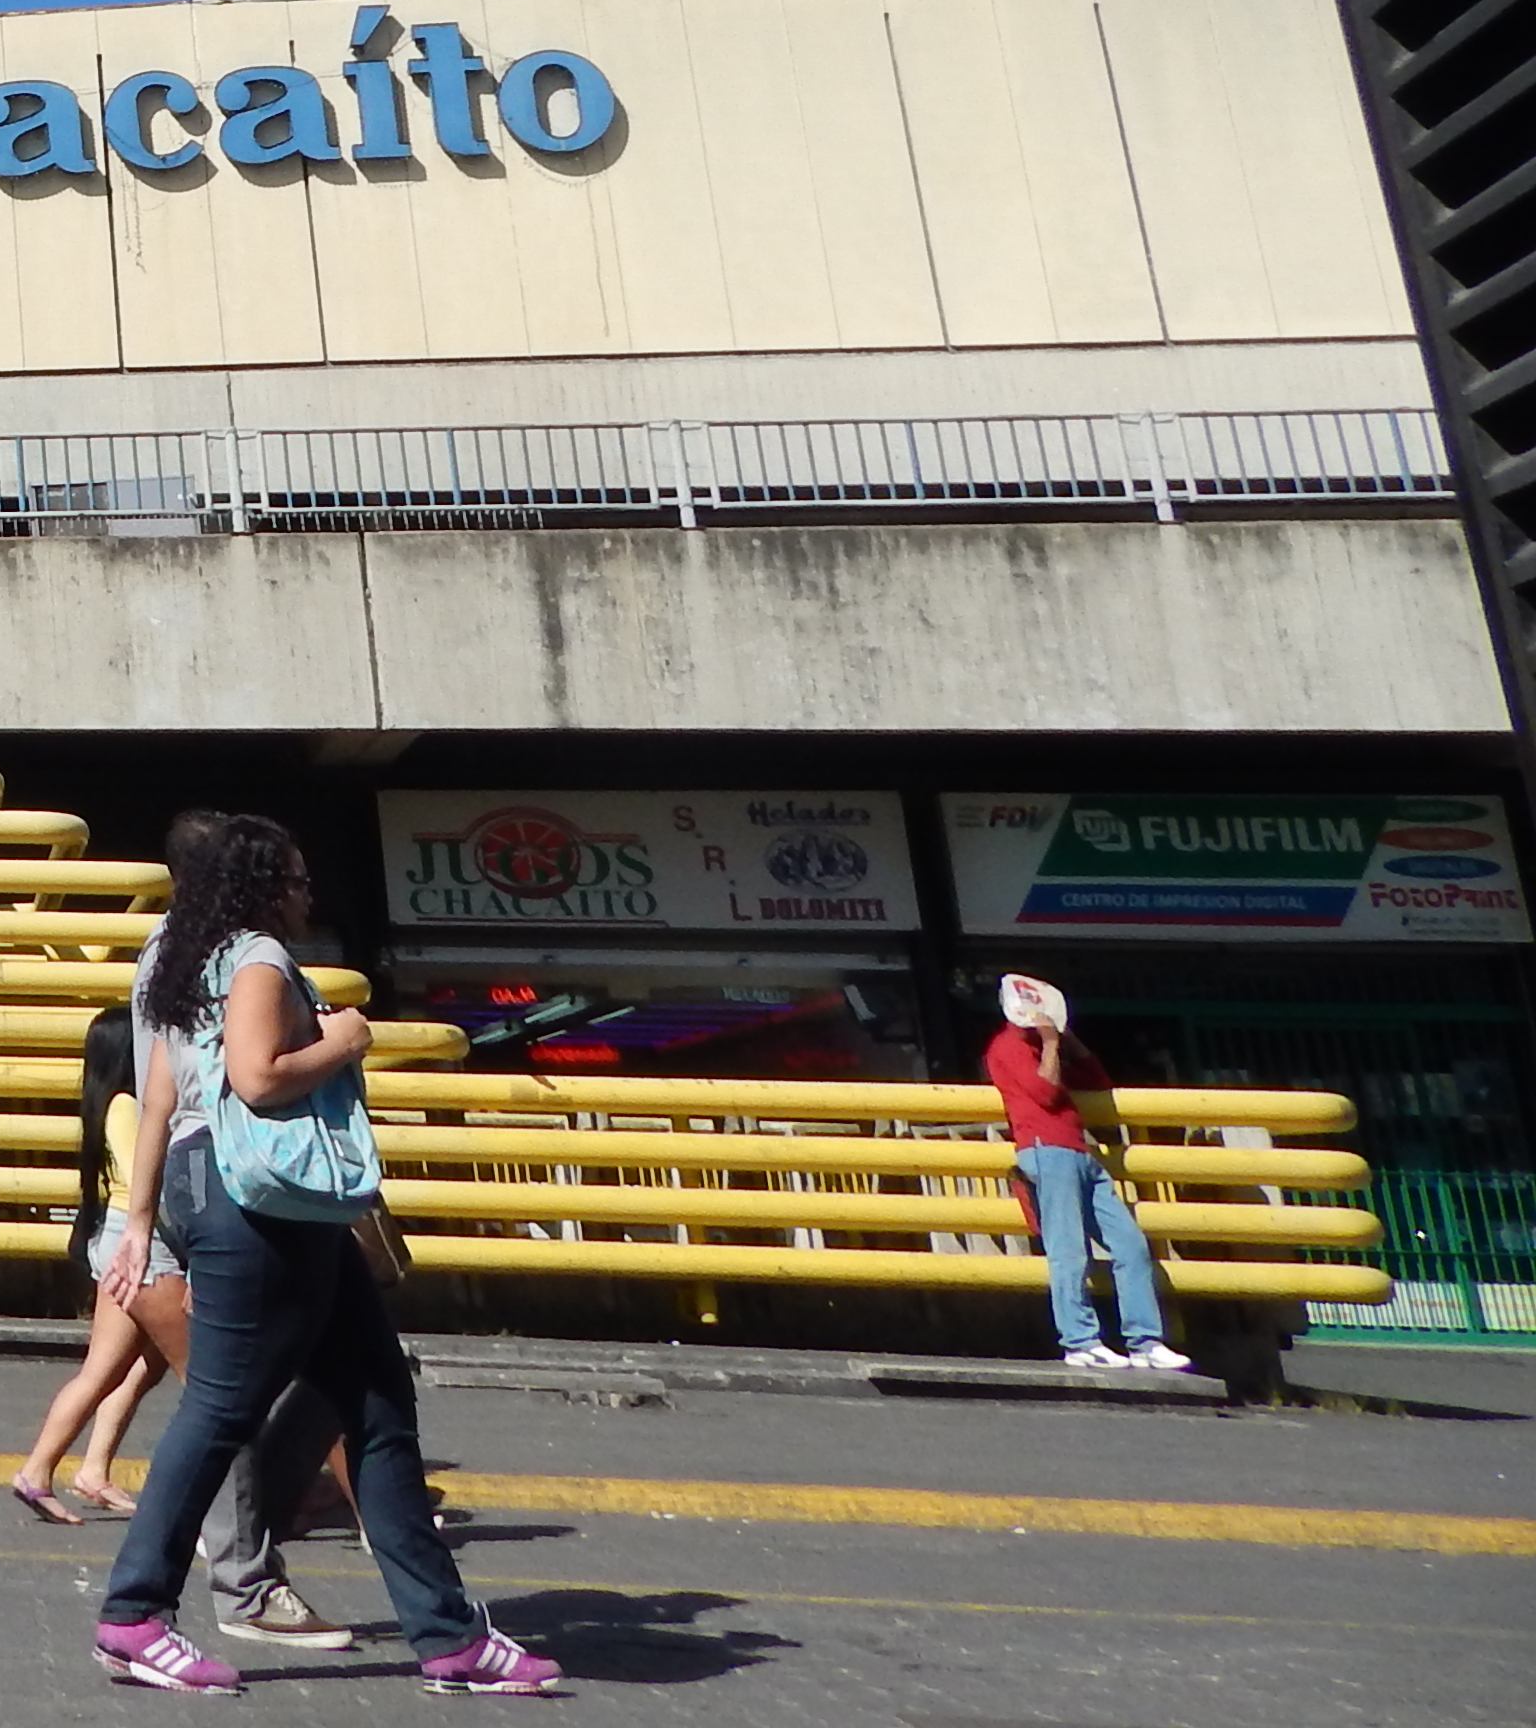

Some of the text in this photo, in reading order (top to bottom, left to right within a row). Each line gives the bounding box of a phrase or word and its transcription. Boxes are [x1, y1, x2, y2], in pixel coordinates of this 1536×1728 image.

[746, 800, 872, 828] Helados
[1138, 816, 1365, 853] FUJIFILM
[405, 839, 654, 888] JUGOS
[759, 898, 887, 922] DOLOMITI
[1061, 892, 1124, 908] CENTRO
[1128, 893, 1150, 908] DE
[1243, 896, 1307, 911] DIGITAL
